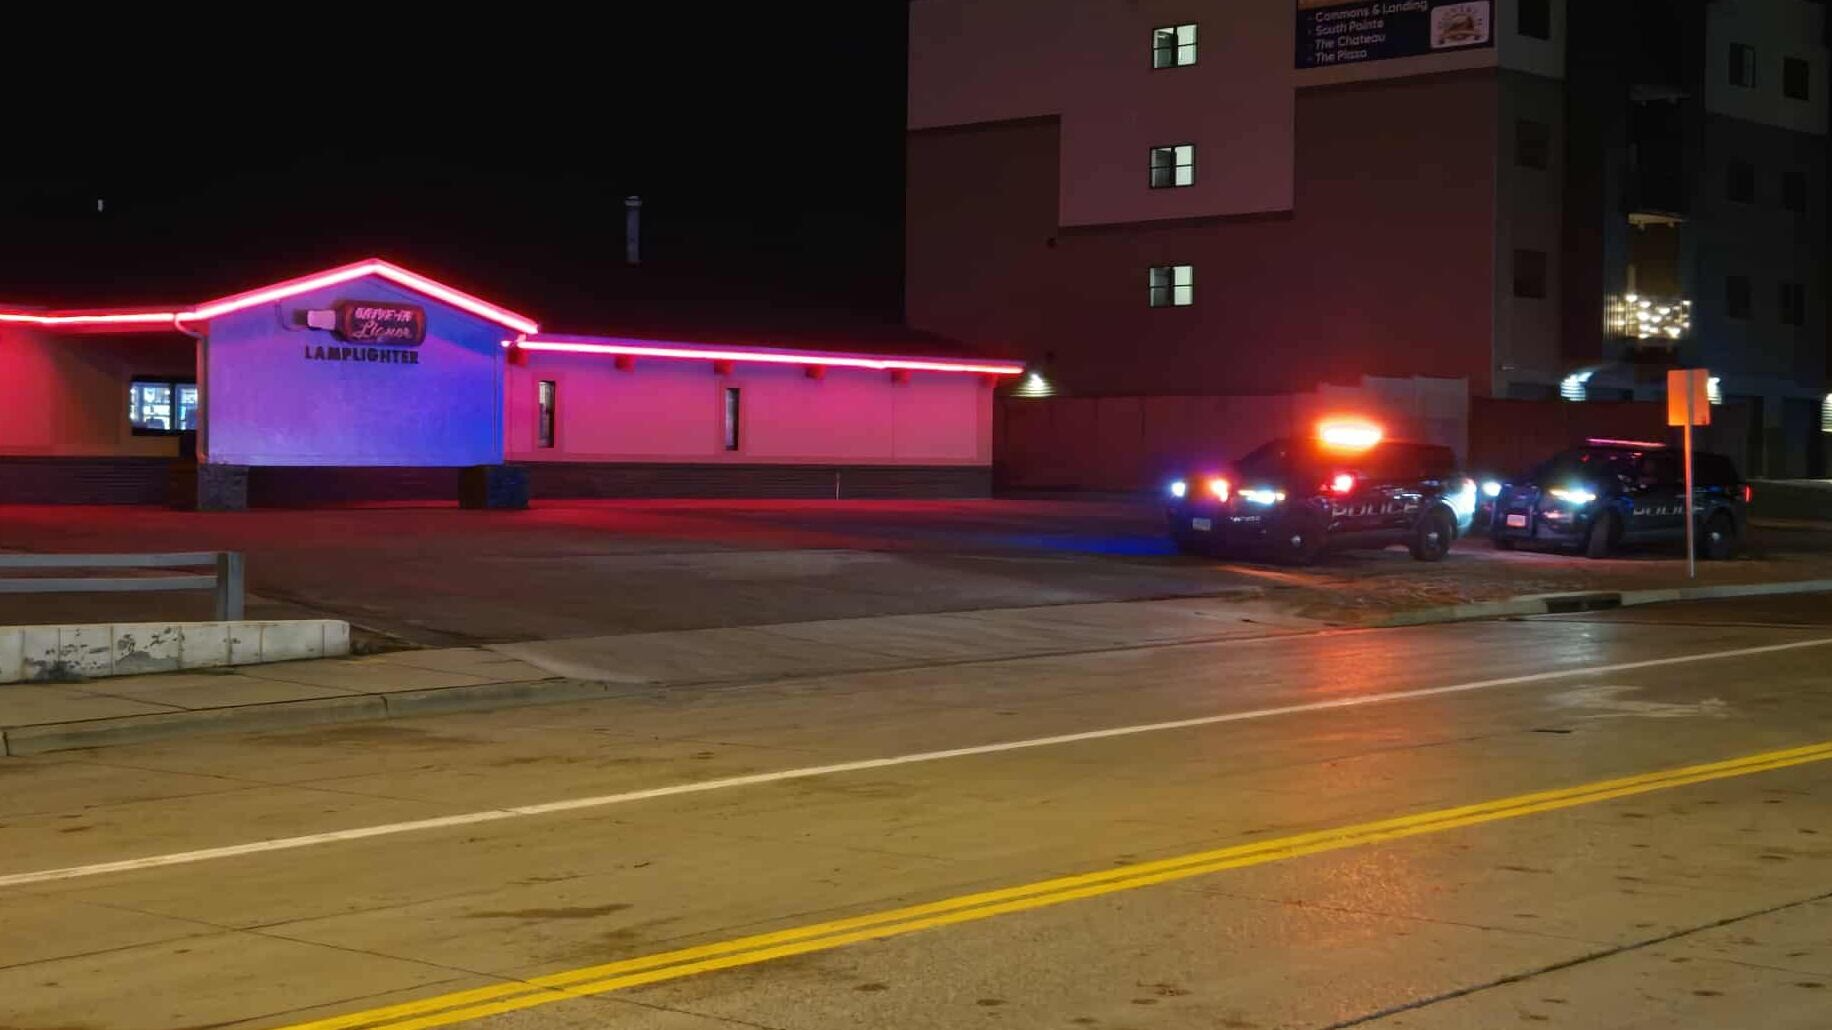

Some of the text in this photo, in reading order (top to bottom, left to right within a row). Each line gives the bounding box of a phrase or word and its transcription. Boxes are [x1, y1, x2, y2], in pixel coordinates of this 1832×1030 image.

[1315, 7, 1369, 22] Commons
[1382, 1, 1427, 15] Landing
[1315, 25, 1347, 36] South
[1315, 33, 1386, 49] The Chateau
[1315, 50, 1368, 63] The Plaza
[304, 345, 419, 364] LAMPLIGHTER
